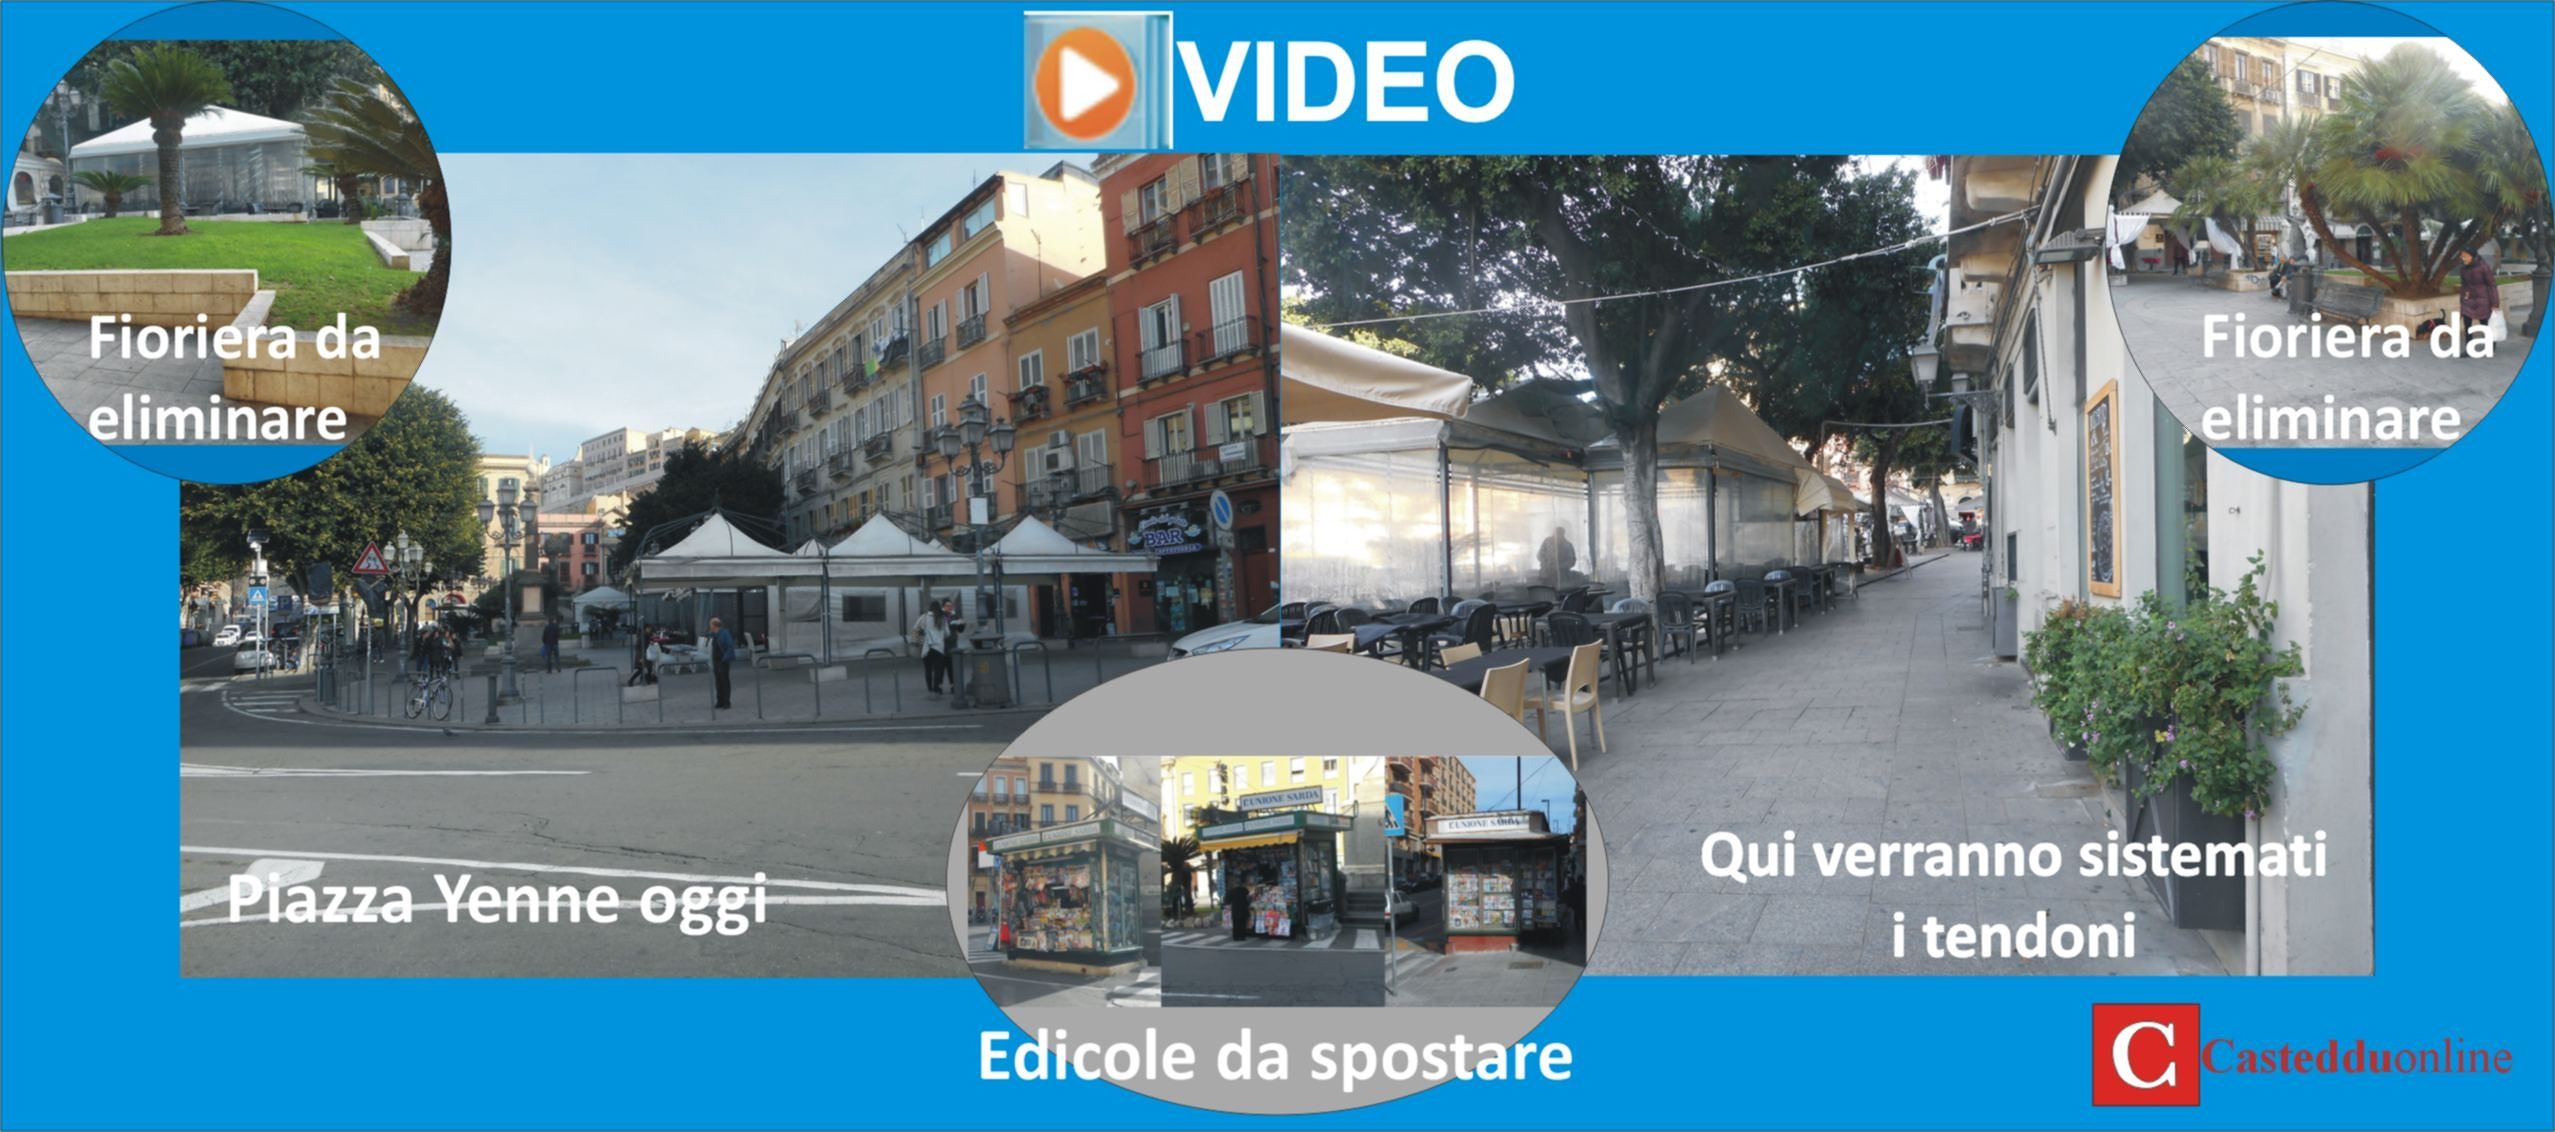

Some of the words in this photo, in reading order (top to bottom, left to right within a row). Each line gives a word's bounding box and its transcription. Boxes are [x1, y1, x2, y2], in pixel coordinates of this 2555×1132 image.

[1143, 528, 1184, 547] BAR
[1242, 793, 1285, 807] L'UNIONE
[1287, 789, 1319, 802] SARDA
[1448, 819, 1488, 830] L'UNIONE
[1490, 817, 1521, 828] SARDA
